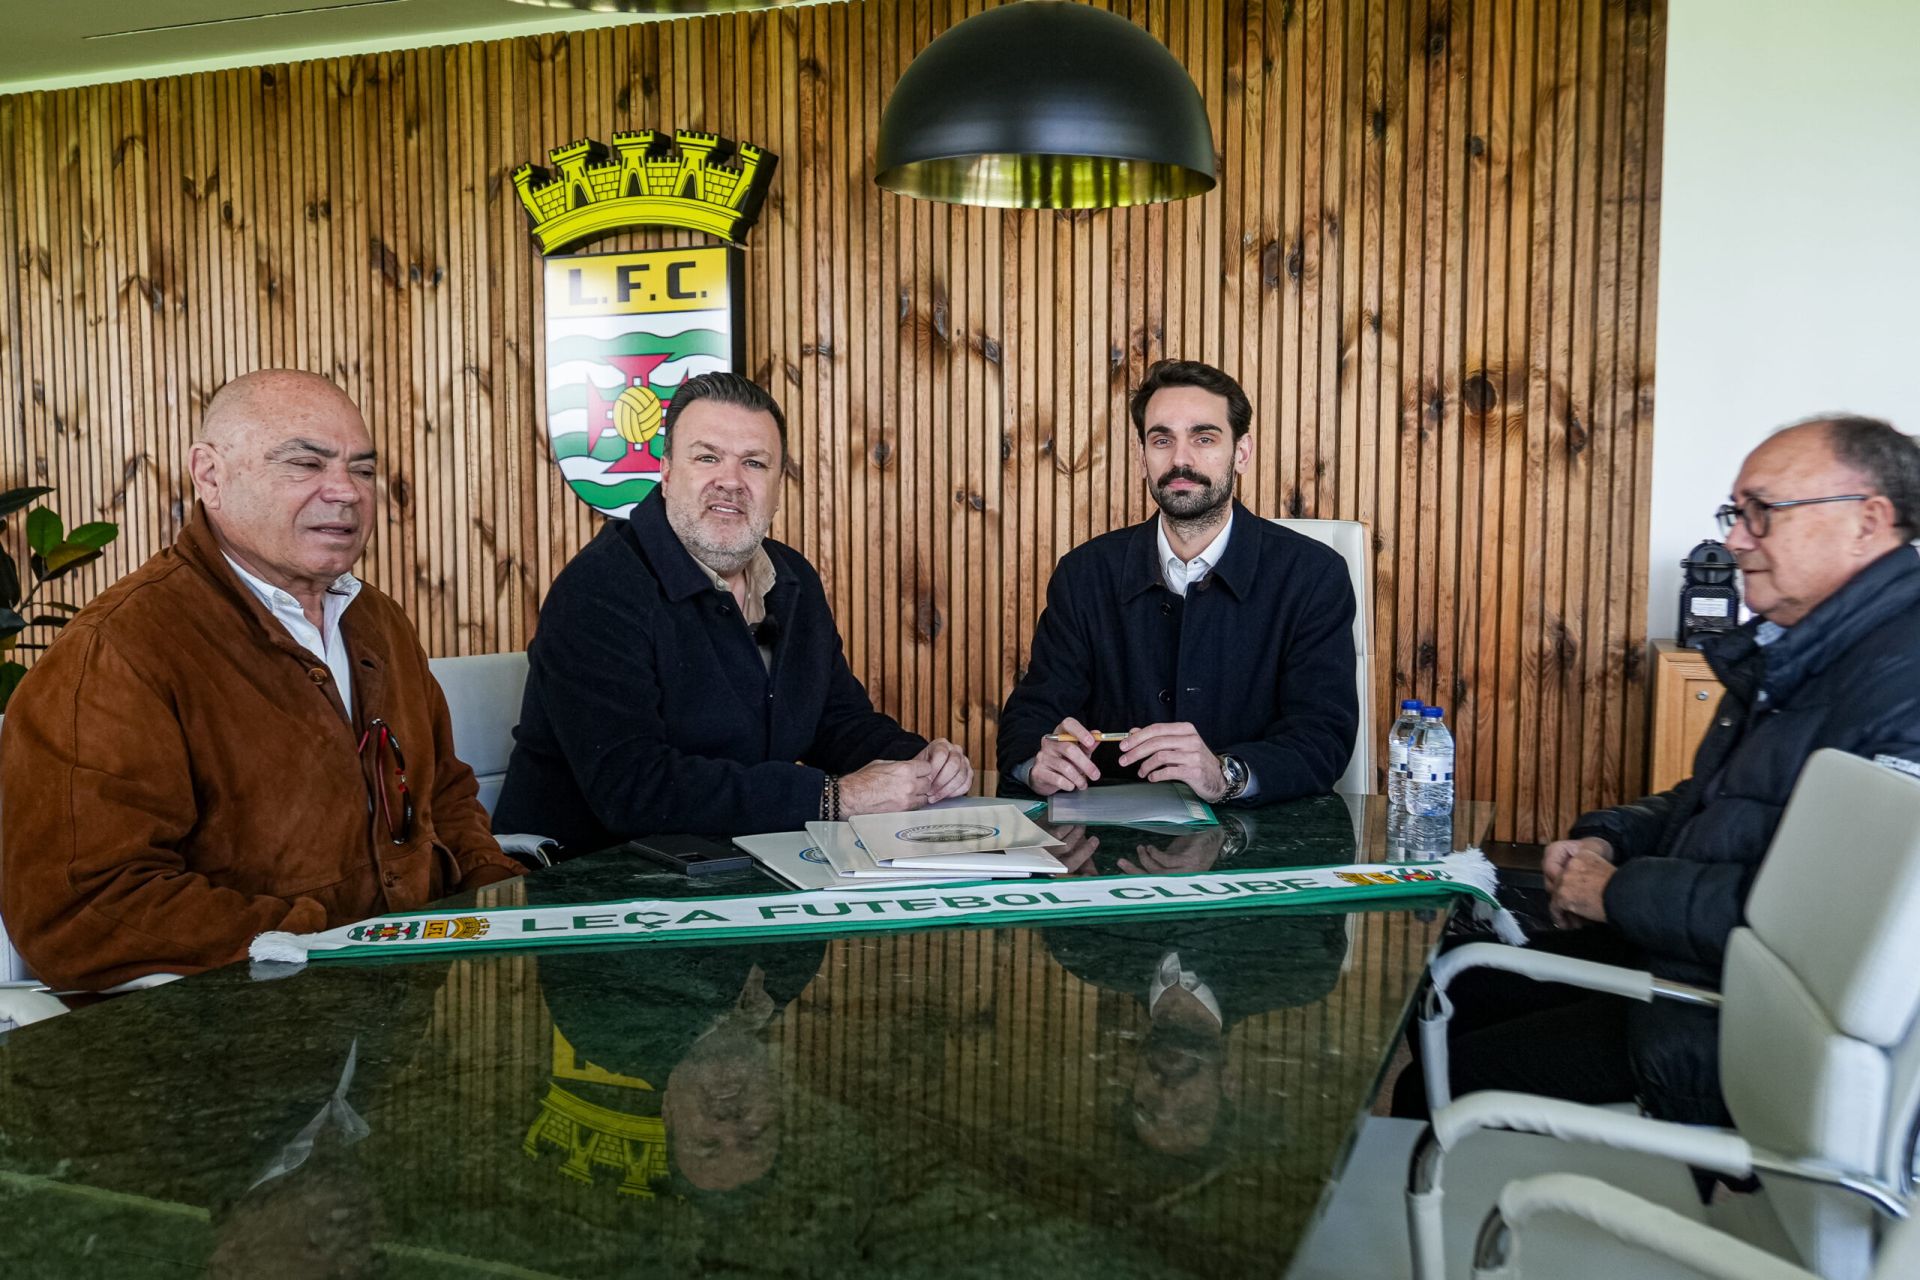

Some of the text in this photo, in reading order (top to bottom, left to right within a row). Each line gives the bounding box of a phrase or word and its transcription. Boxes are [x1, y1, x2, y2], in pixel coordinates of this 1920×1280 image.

[568, 261, 708, 305] L.F.C.
[522, 878, 1331, 929] LEÇA FUTEBOL CLUBE
